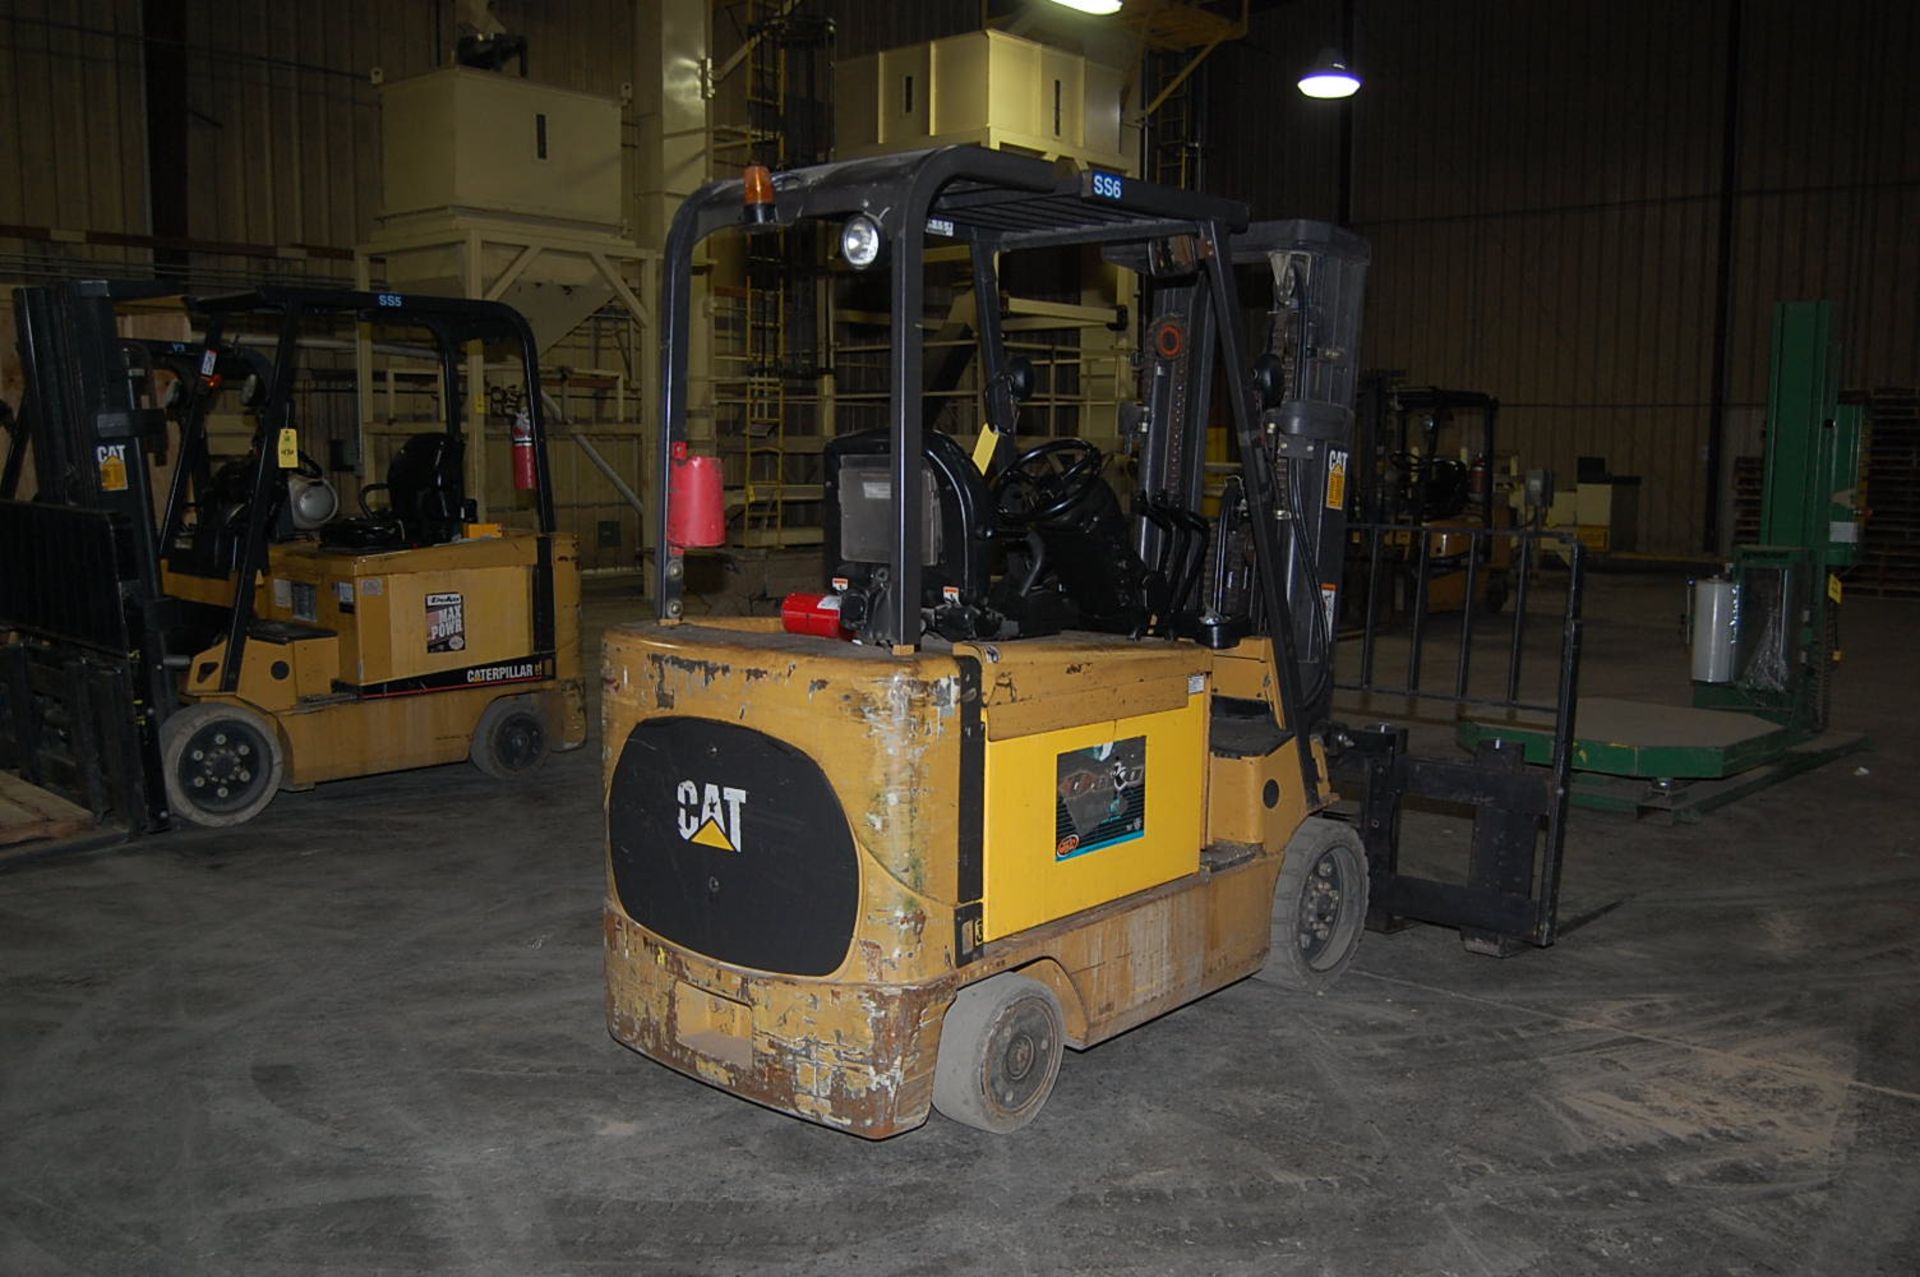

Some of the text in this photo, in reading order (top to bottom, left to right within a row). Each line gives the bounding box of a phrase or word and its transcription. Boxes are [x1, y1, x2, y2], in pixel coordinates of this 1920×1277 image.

[1093, 175, 1122, 199] SS6
[379, 294, 402, 307] SS5
[97, 445, 126, 464] CAT
[1328, 449, 1348, 475] CAT
[438, 605, 462, 624] MAX
[430, 619, 463, 640] POWR
[467, 663, 533, 683] CATERPILLAR
[677, 779, 747, 853] CAT
